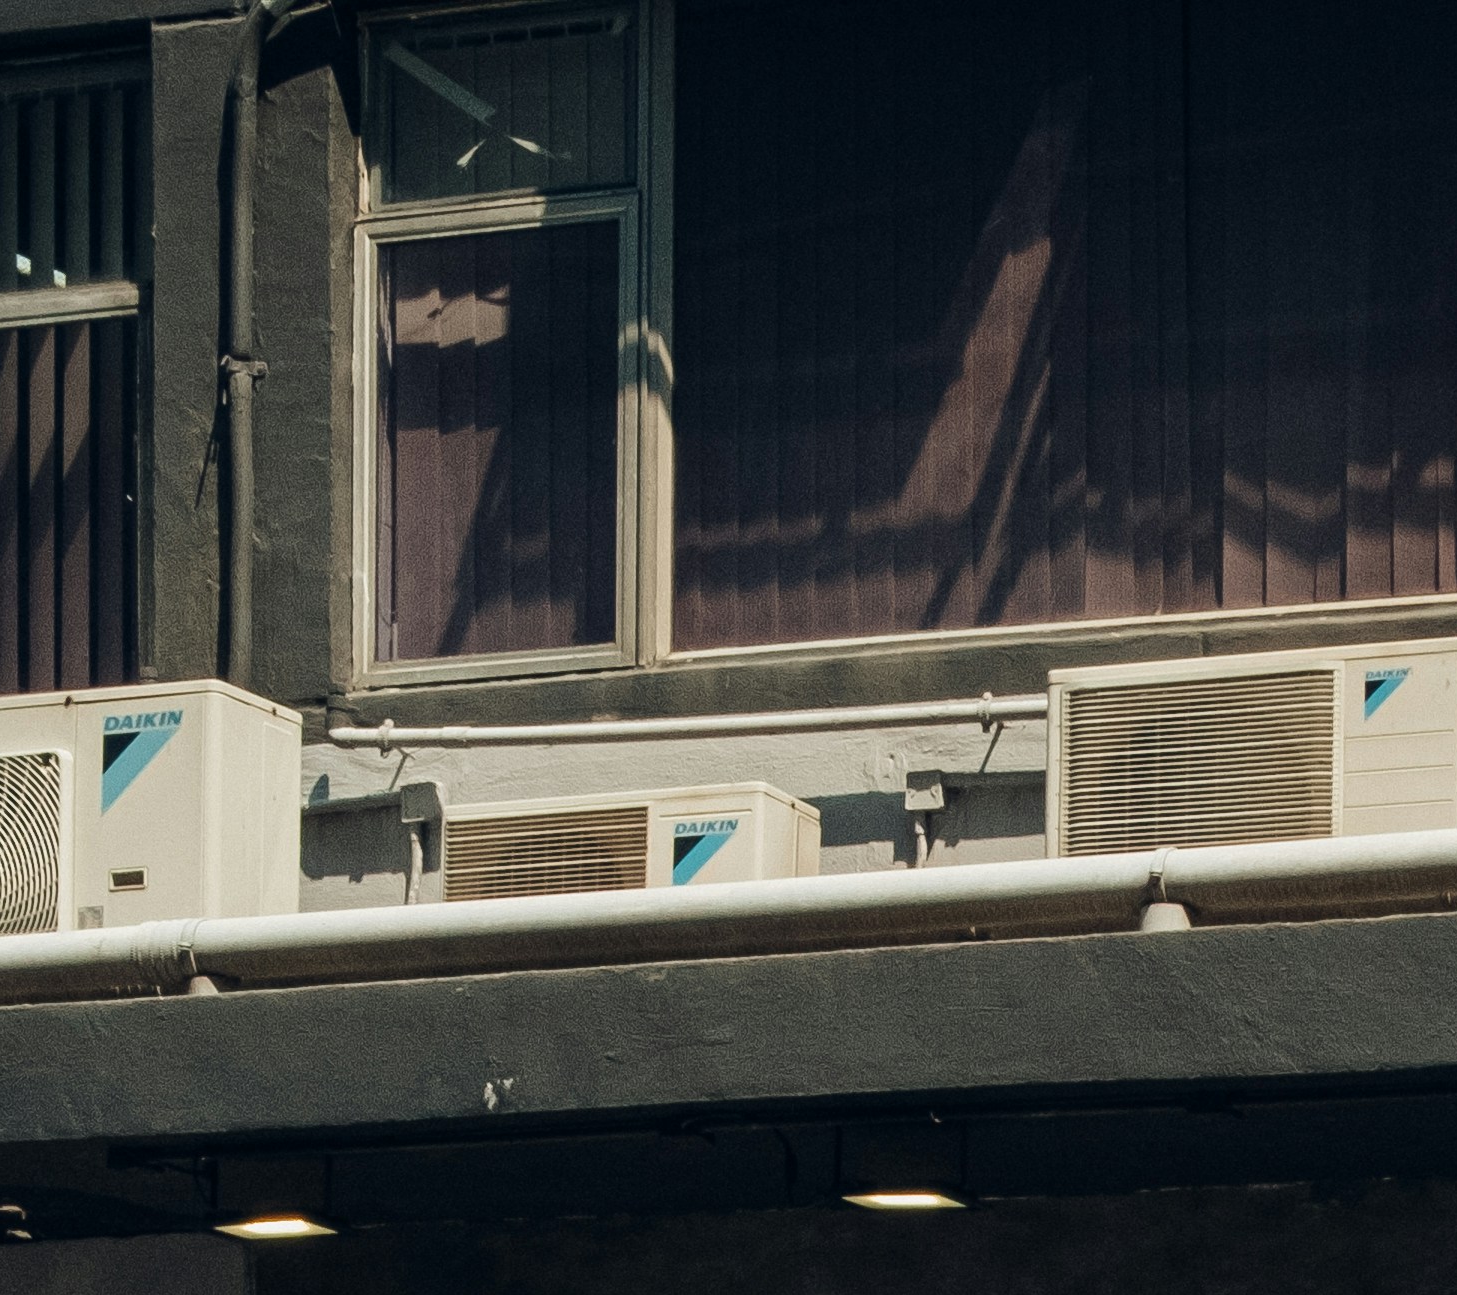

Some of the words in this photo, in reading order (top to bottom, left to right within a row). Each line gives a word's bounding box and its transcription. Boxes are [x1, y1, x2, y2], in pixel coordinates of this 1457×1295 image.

[1365, 668, 1411, 680] DAIKIN
[104, 710, 184, 731] DAIKIN
[674, 819, 739, 835] DAIKIN
